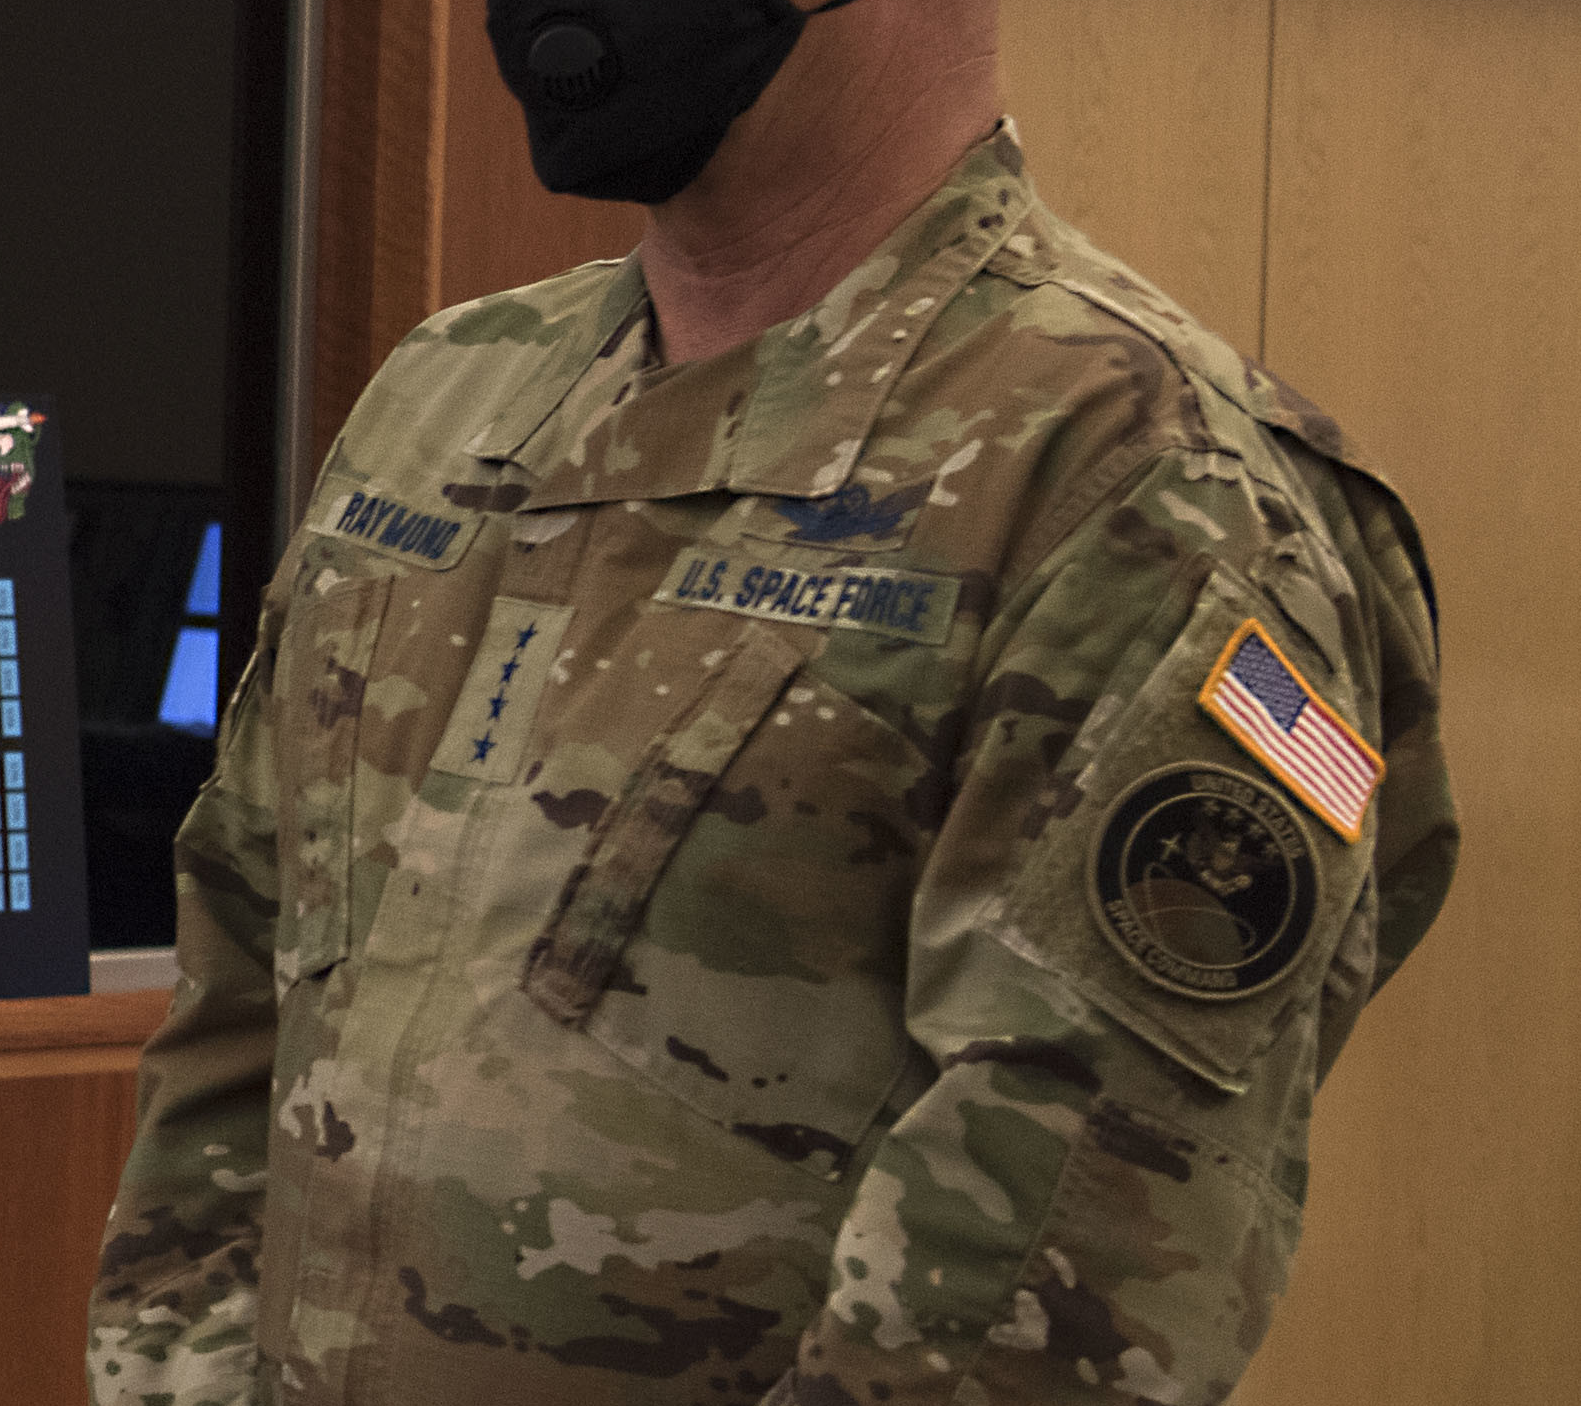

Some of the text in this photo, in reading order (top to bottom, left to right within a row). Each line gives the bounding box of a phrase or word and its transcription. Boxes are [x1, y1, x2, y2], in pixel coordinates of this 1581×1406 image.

[335, 491, 462, 562] RAYMOND
[675, 557, 937, 633] U.S. SPACE FORCE
